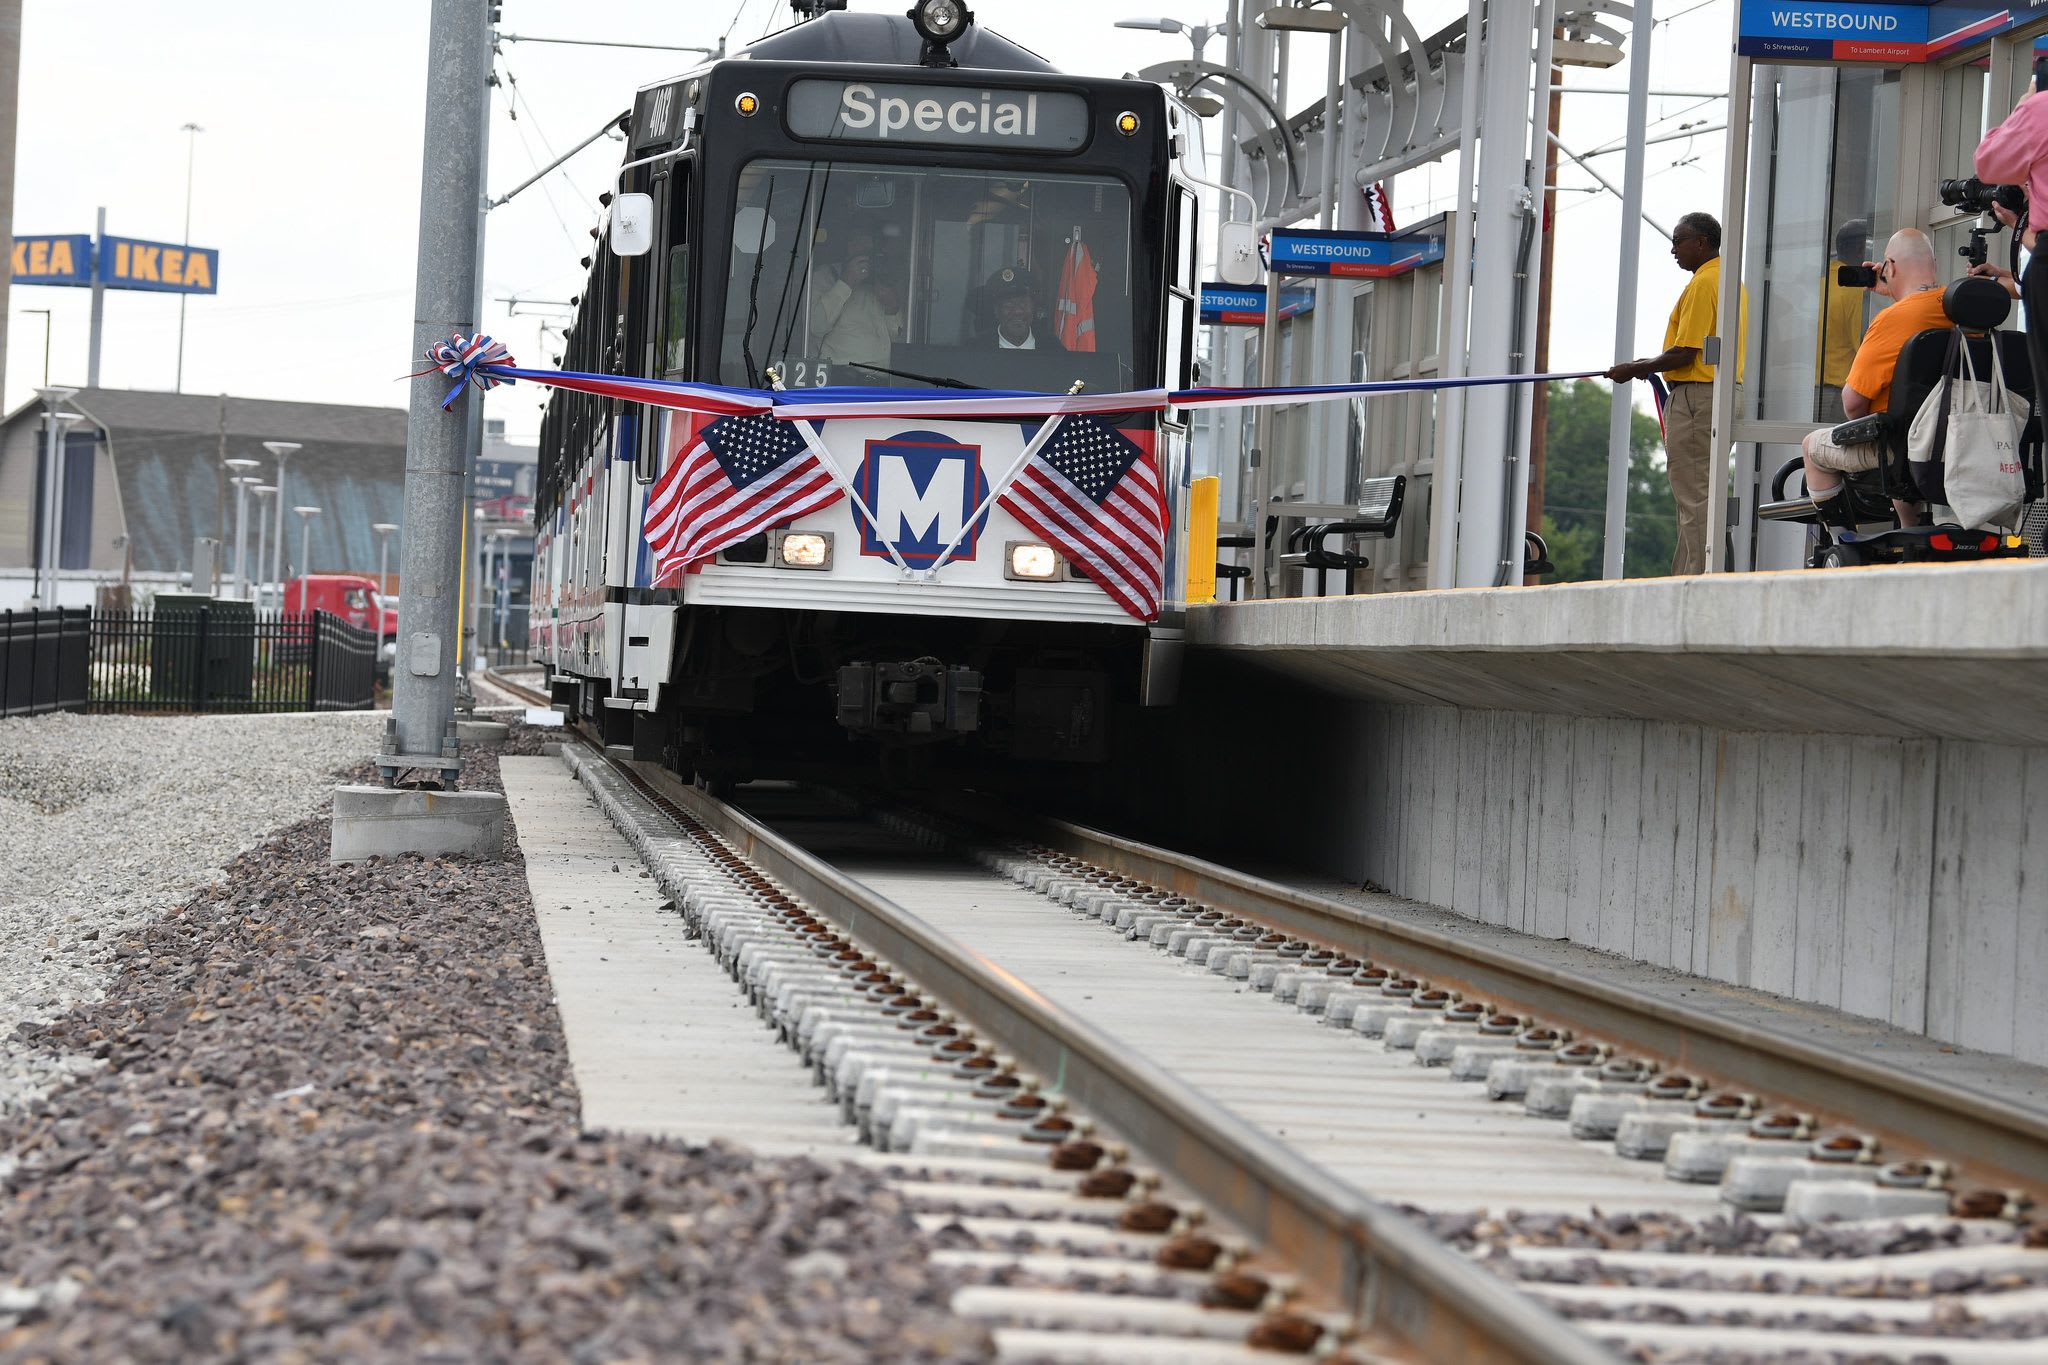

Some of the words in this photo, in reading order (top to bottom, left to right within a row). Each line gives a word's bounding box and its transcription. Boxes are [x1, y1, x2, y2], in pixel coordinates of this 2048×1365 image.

[1771, 11, 1898, 31] WESTBOUND
[1772, 43, 1810, 52] Shrewsbury
[1850, 46, 1858, 54] To
[1859, 47, 1886, 55] Lambert
[1887, 48, 1910, 56] Airport
[840, 84, 1037, 138] Special
[13, 240, 75, 276] KEA
[1291, 243, 1371, 257] WESTBOUND
[114, 243, 212, 288] IKEA
[1200, 294, 1257, 307] ESTBOUND
[876, 454, 965, 545] M
[1953, 543, 1979, 552] Jazzy
